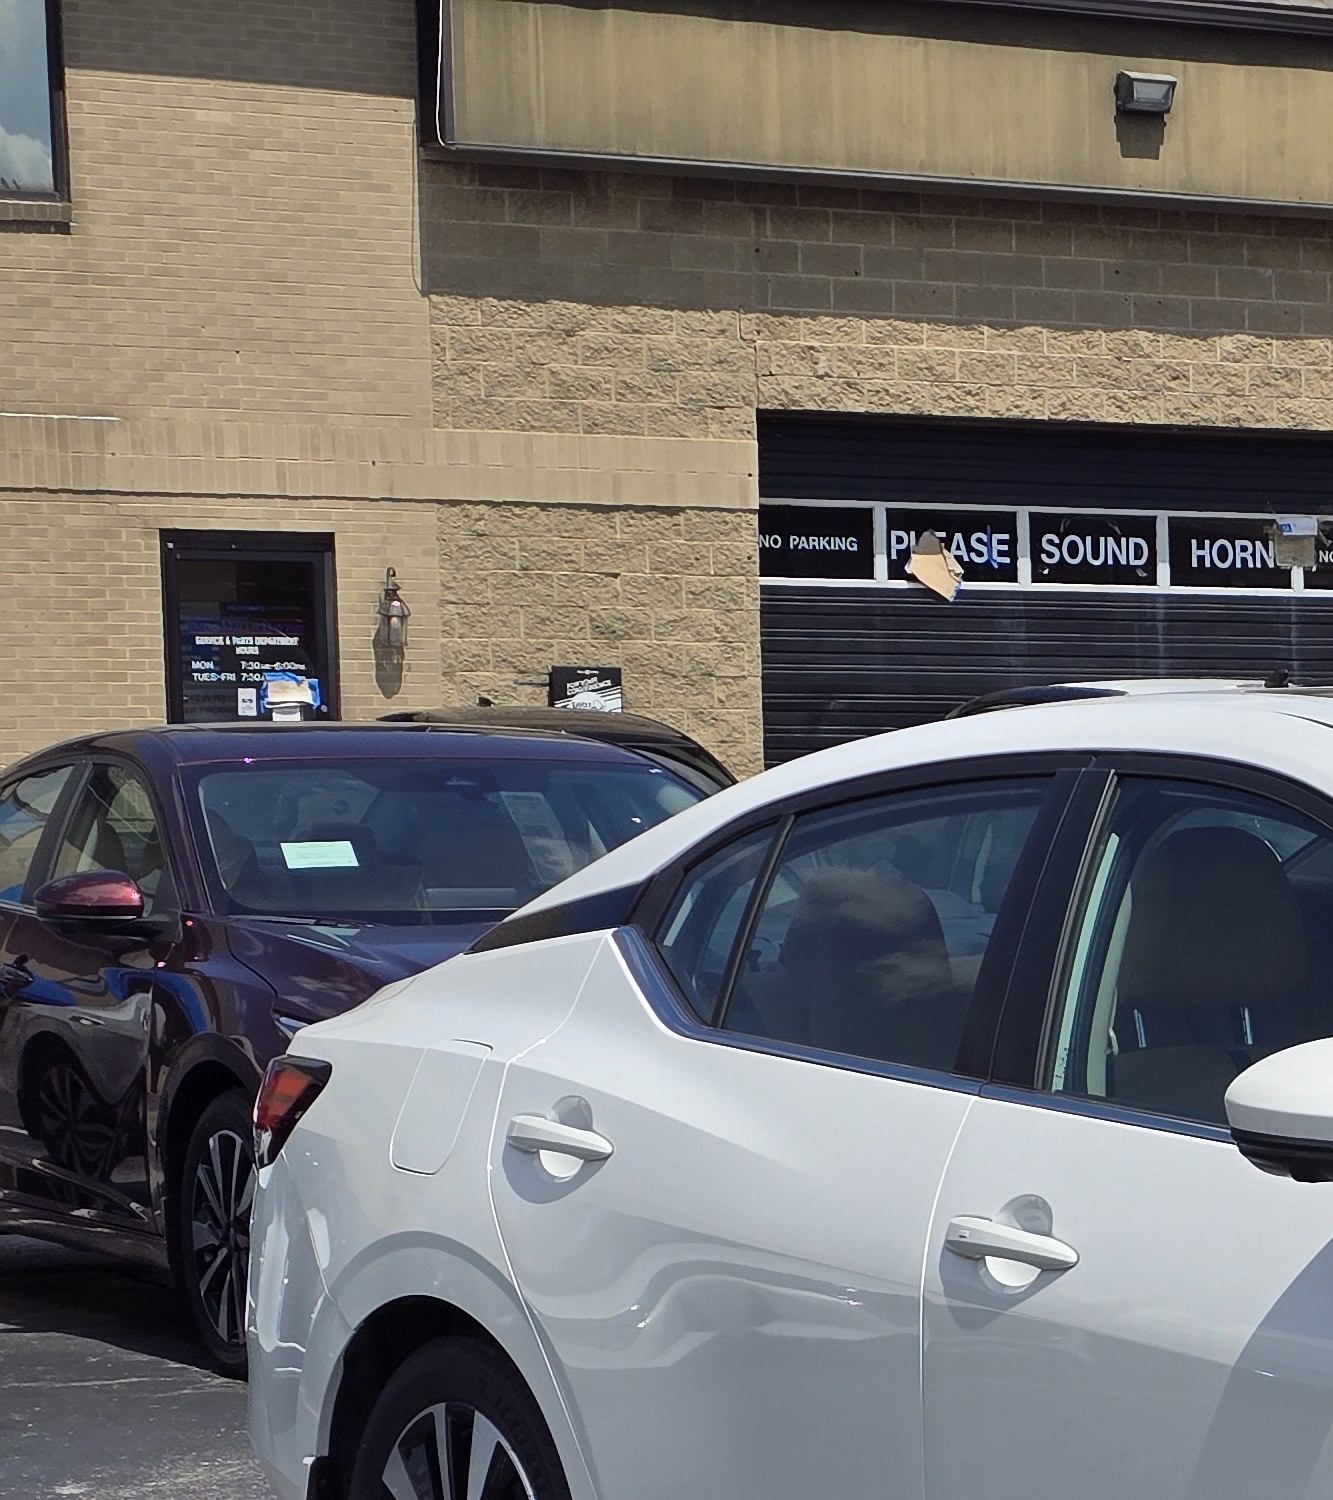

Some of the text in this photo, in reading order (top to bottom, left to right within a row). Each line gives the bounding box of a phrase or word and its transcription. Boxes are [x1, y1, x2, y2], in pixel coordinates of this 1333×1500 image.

[759, 534, 858, 551] NO PARKING
[891, 530, 1275, 568] PASE SOUND HORN
[191, 661, 214, 670] MON
